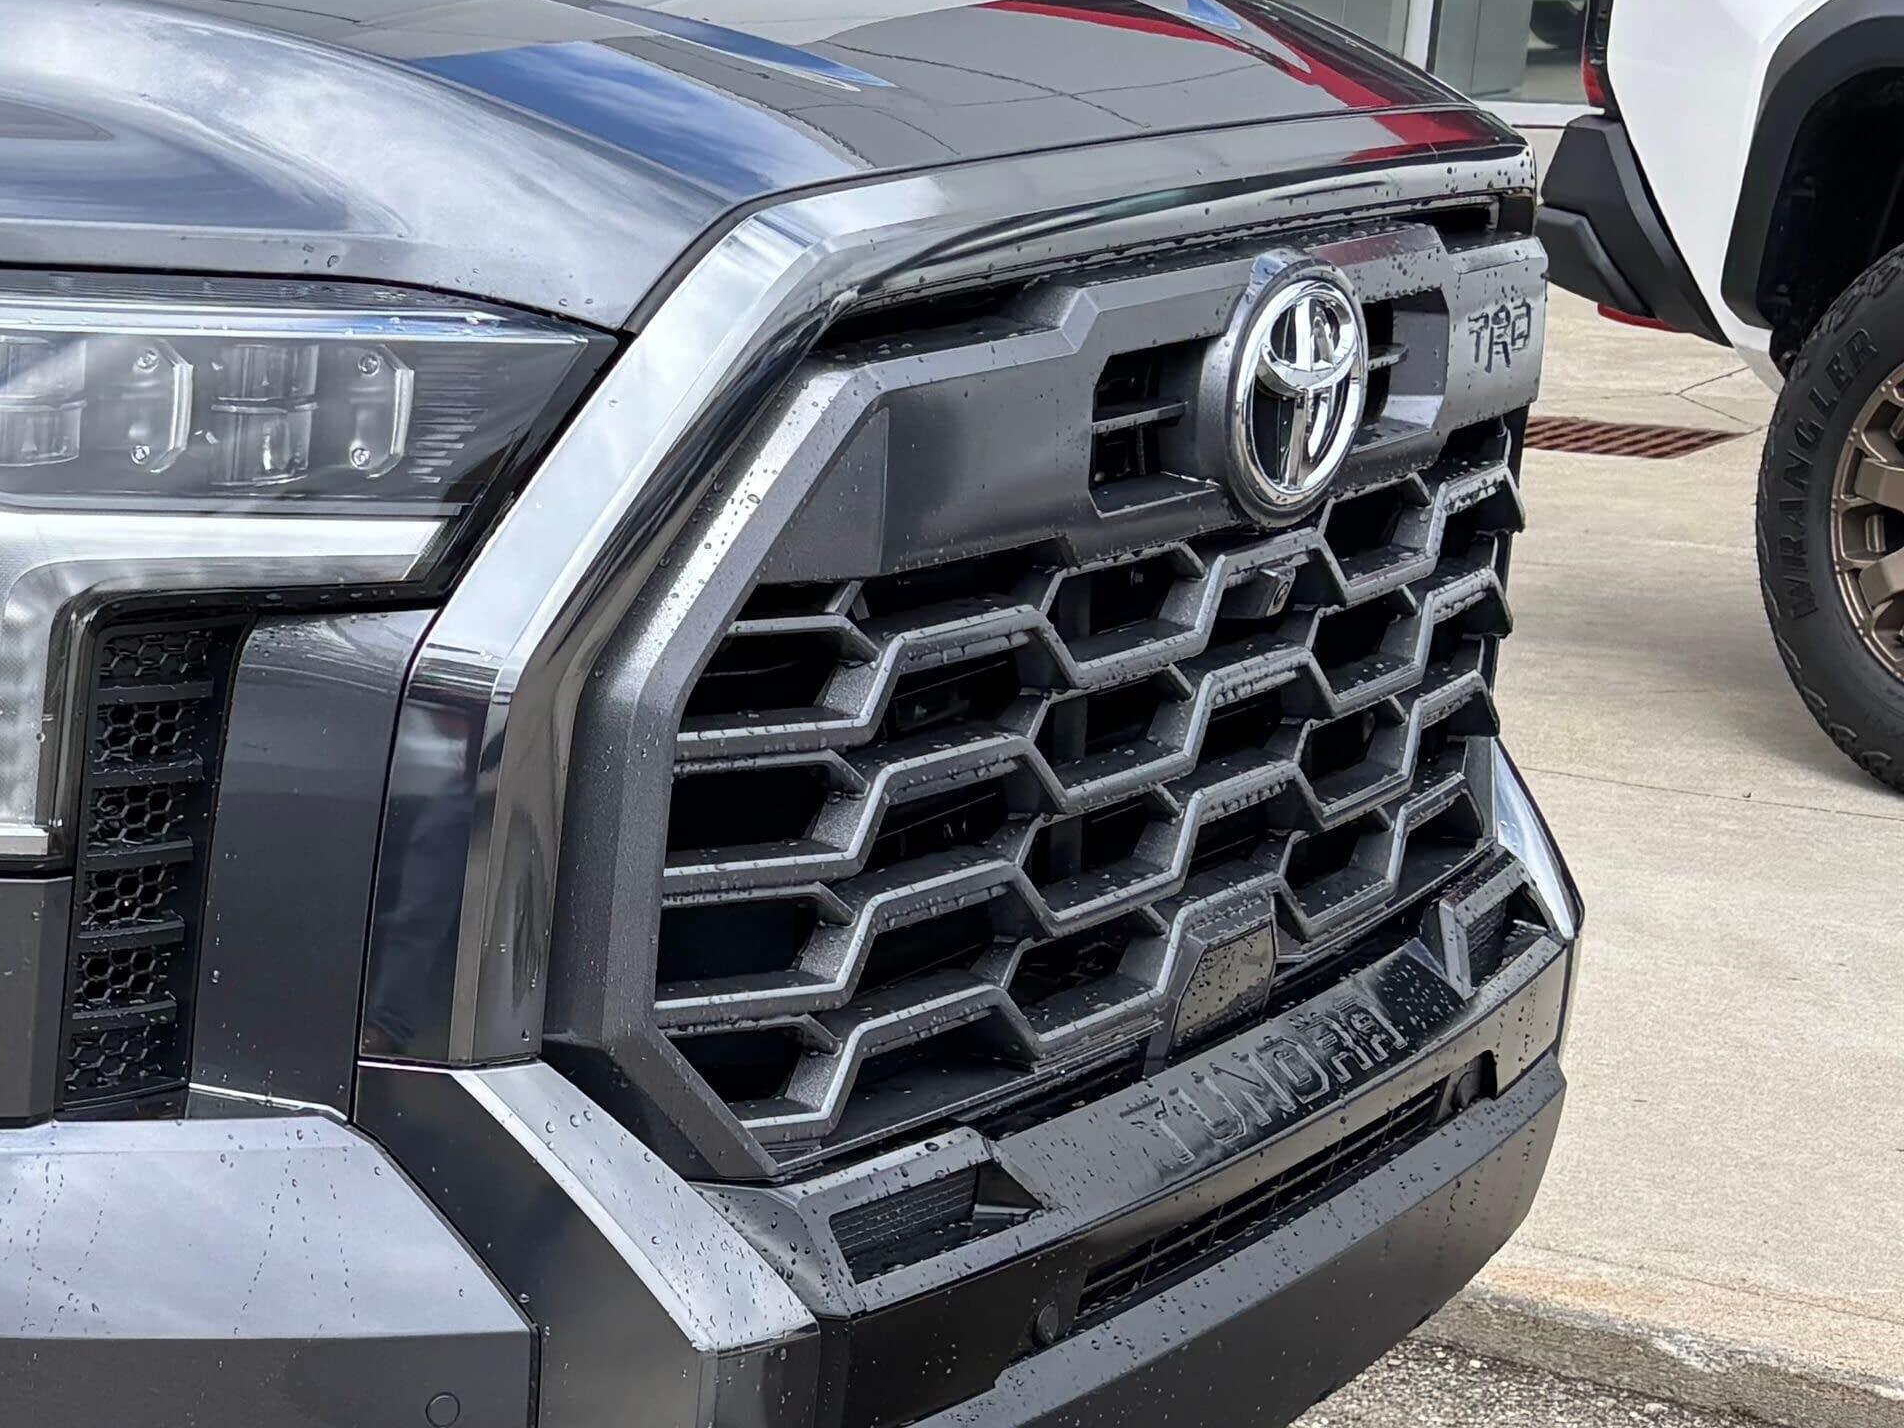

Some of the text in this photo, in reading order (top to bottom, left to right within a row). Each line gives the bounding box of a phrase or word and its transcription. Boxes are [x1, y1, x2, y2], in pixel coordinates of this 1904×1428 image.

[1468, 299, 1531, 370] TRD
[1777, 328, 1878, 620] WRANGLER
[1119, 995, 1411, 1167] TUNDRA
